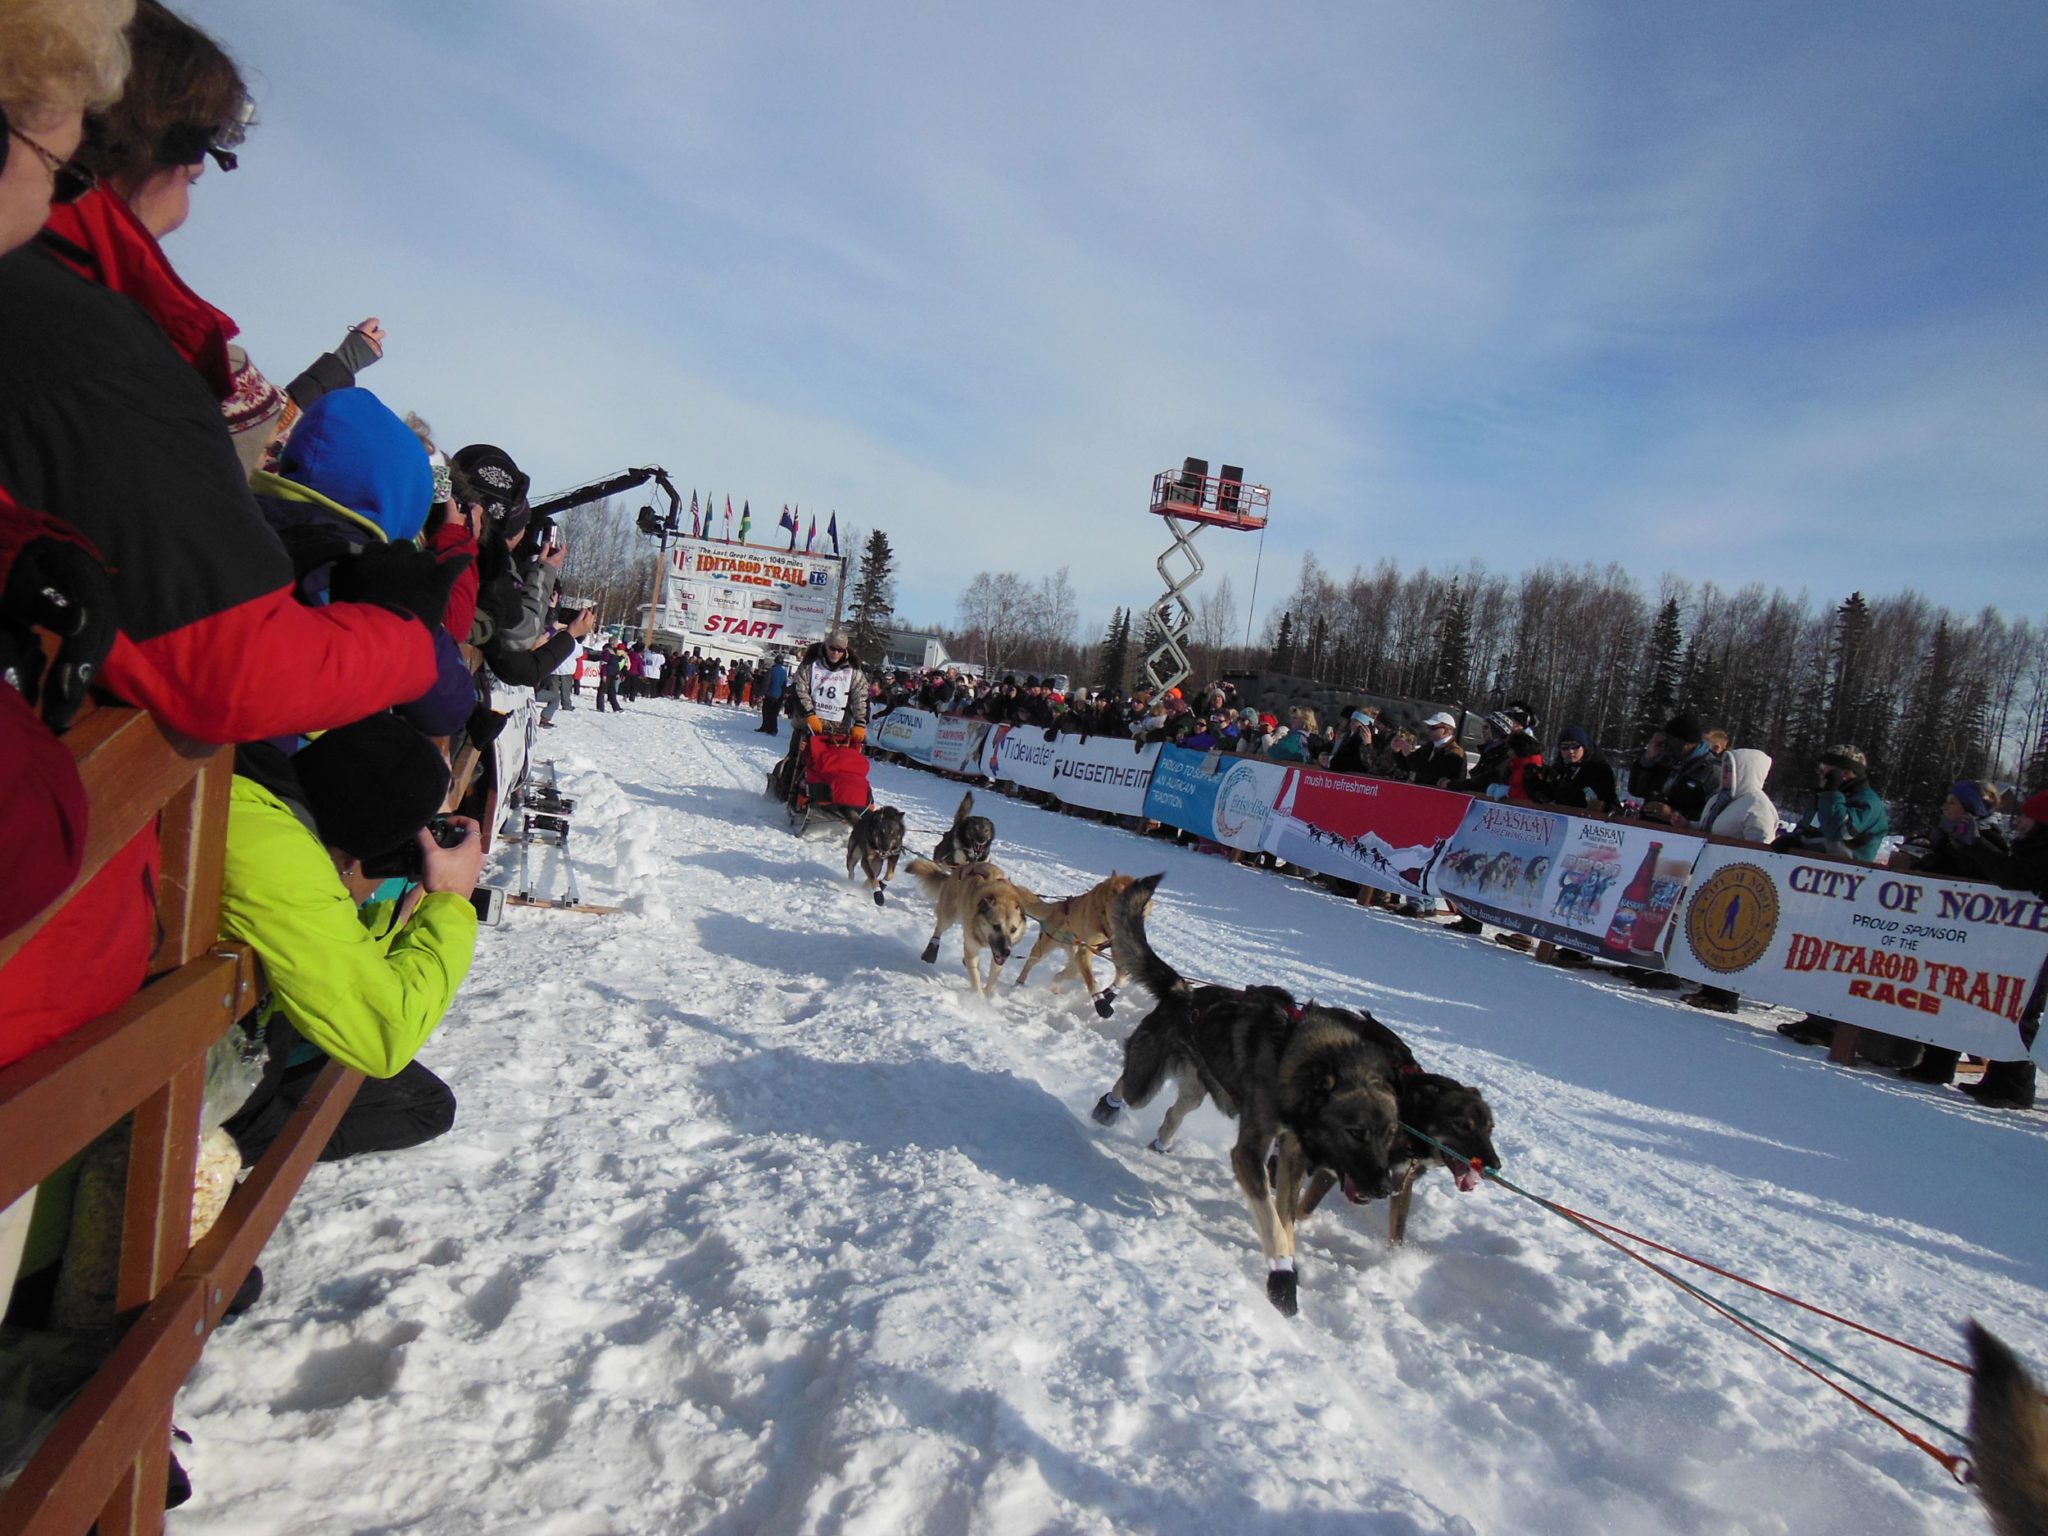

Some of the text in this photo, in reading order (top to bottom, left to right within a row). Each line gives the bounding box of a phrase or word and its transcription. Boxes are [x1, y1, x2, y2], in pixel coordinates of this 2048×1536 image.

[696, 554, 761, 574] IDITAROD
[763, 564, 808, 587] TRAIL
[729, 551, 746, 559] Great
[769, 556, 786, 564] 1049
[787, 559, 804, 567] miles
[730, 574, 772, 587] RACE
[812, 571, 826, 584] 13
[704, 614, 784, 640] START
[818, 686, 836, 699] 18
[1005, 736, 1055, 767] Tidewater
[1304, 775, 1379, 797] mush to refreshment
[1472, 807, 1555, 847] ALASKAN
[1579, 824, 1625, 847] ALASKAN
[1789, 865, 1866, 902] CITY
[1878, 881, 1923, 914] OF
[1852, 914, 1968, 943] PROUD SPONSOR
[1881, 935, 1919, 951] OF THE
[1784, 933, 2027, 1025] IDITAROD TRAIL
[1848, 979, 1942, 1016] RACE
